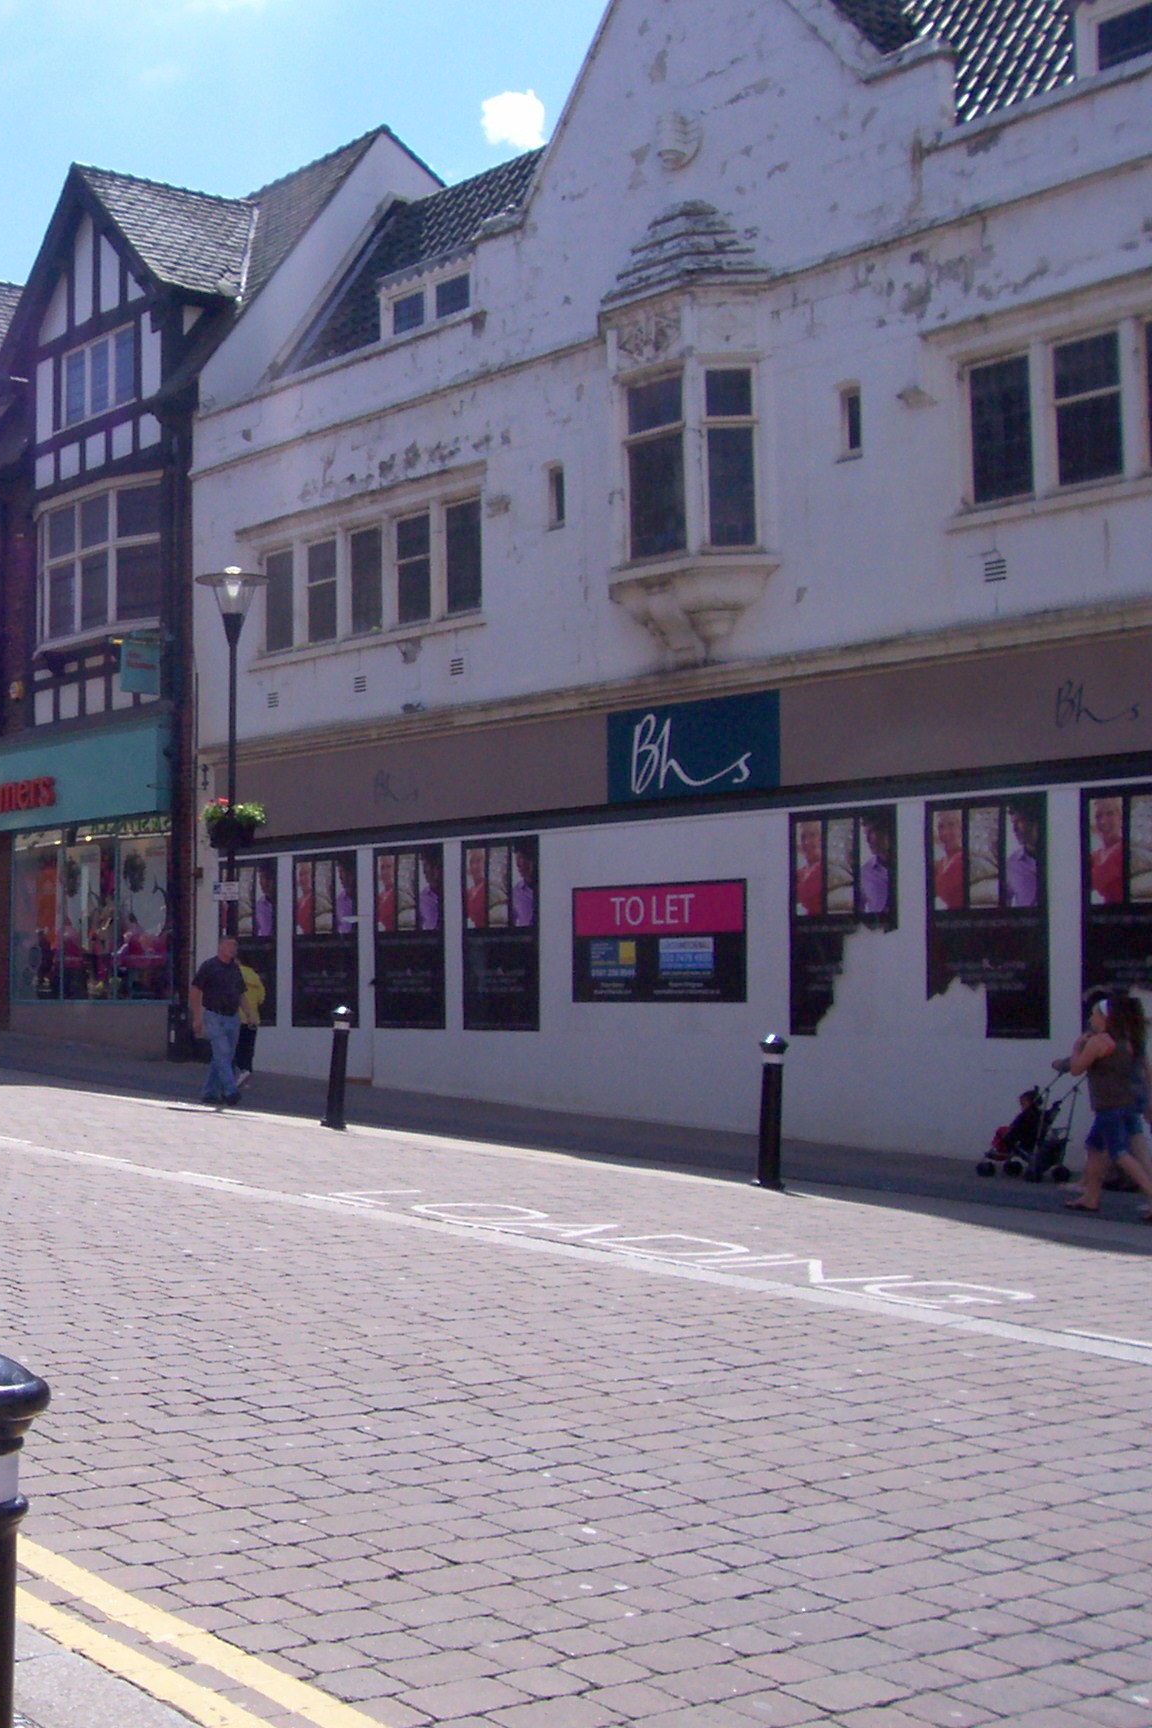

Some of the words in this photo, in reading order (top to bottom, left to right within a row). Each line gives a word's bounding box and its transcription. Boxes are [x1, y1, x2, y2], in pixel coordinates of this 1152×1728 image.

[1055, 680, 1140, 728] Bhs
[631, 714, 752, 795] Bhs
[610, 895, 645, 926] TO
[651, 893, 695, 925] LET
[302, 1189, 1036, 1310] LOADING
